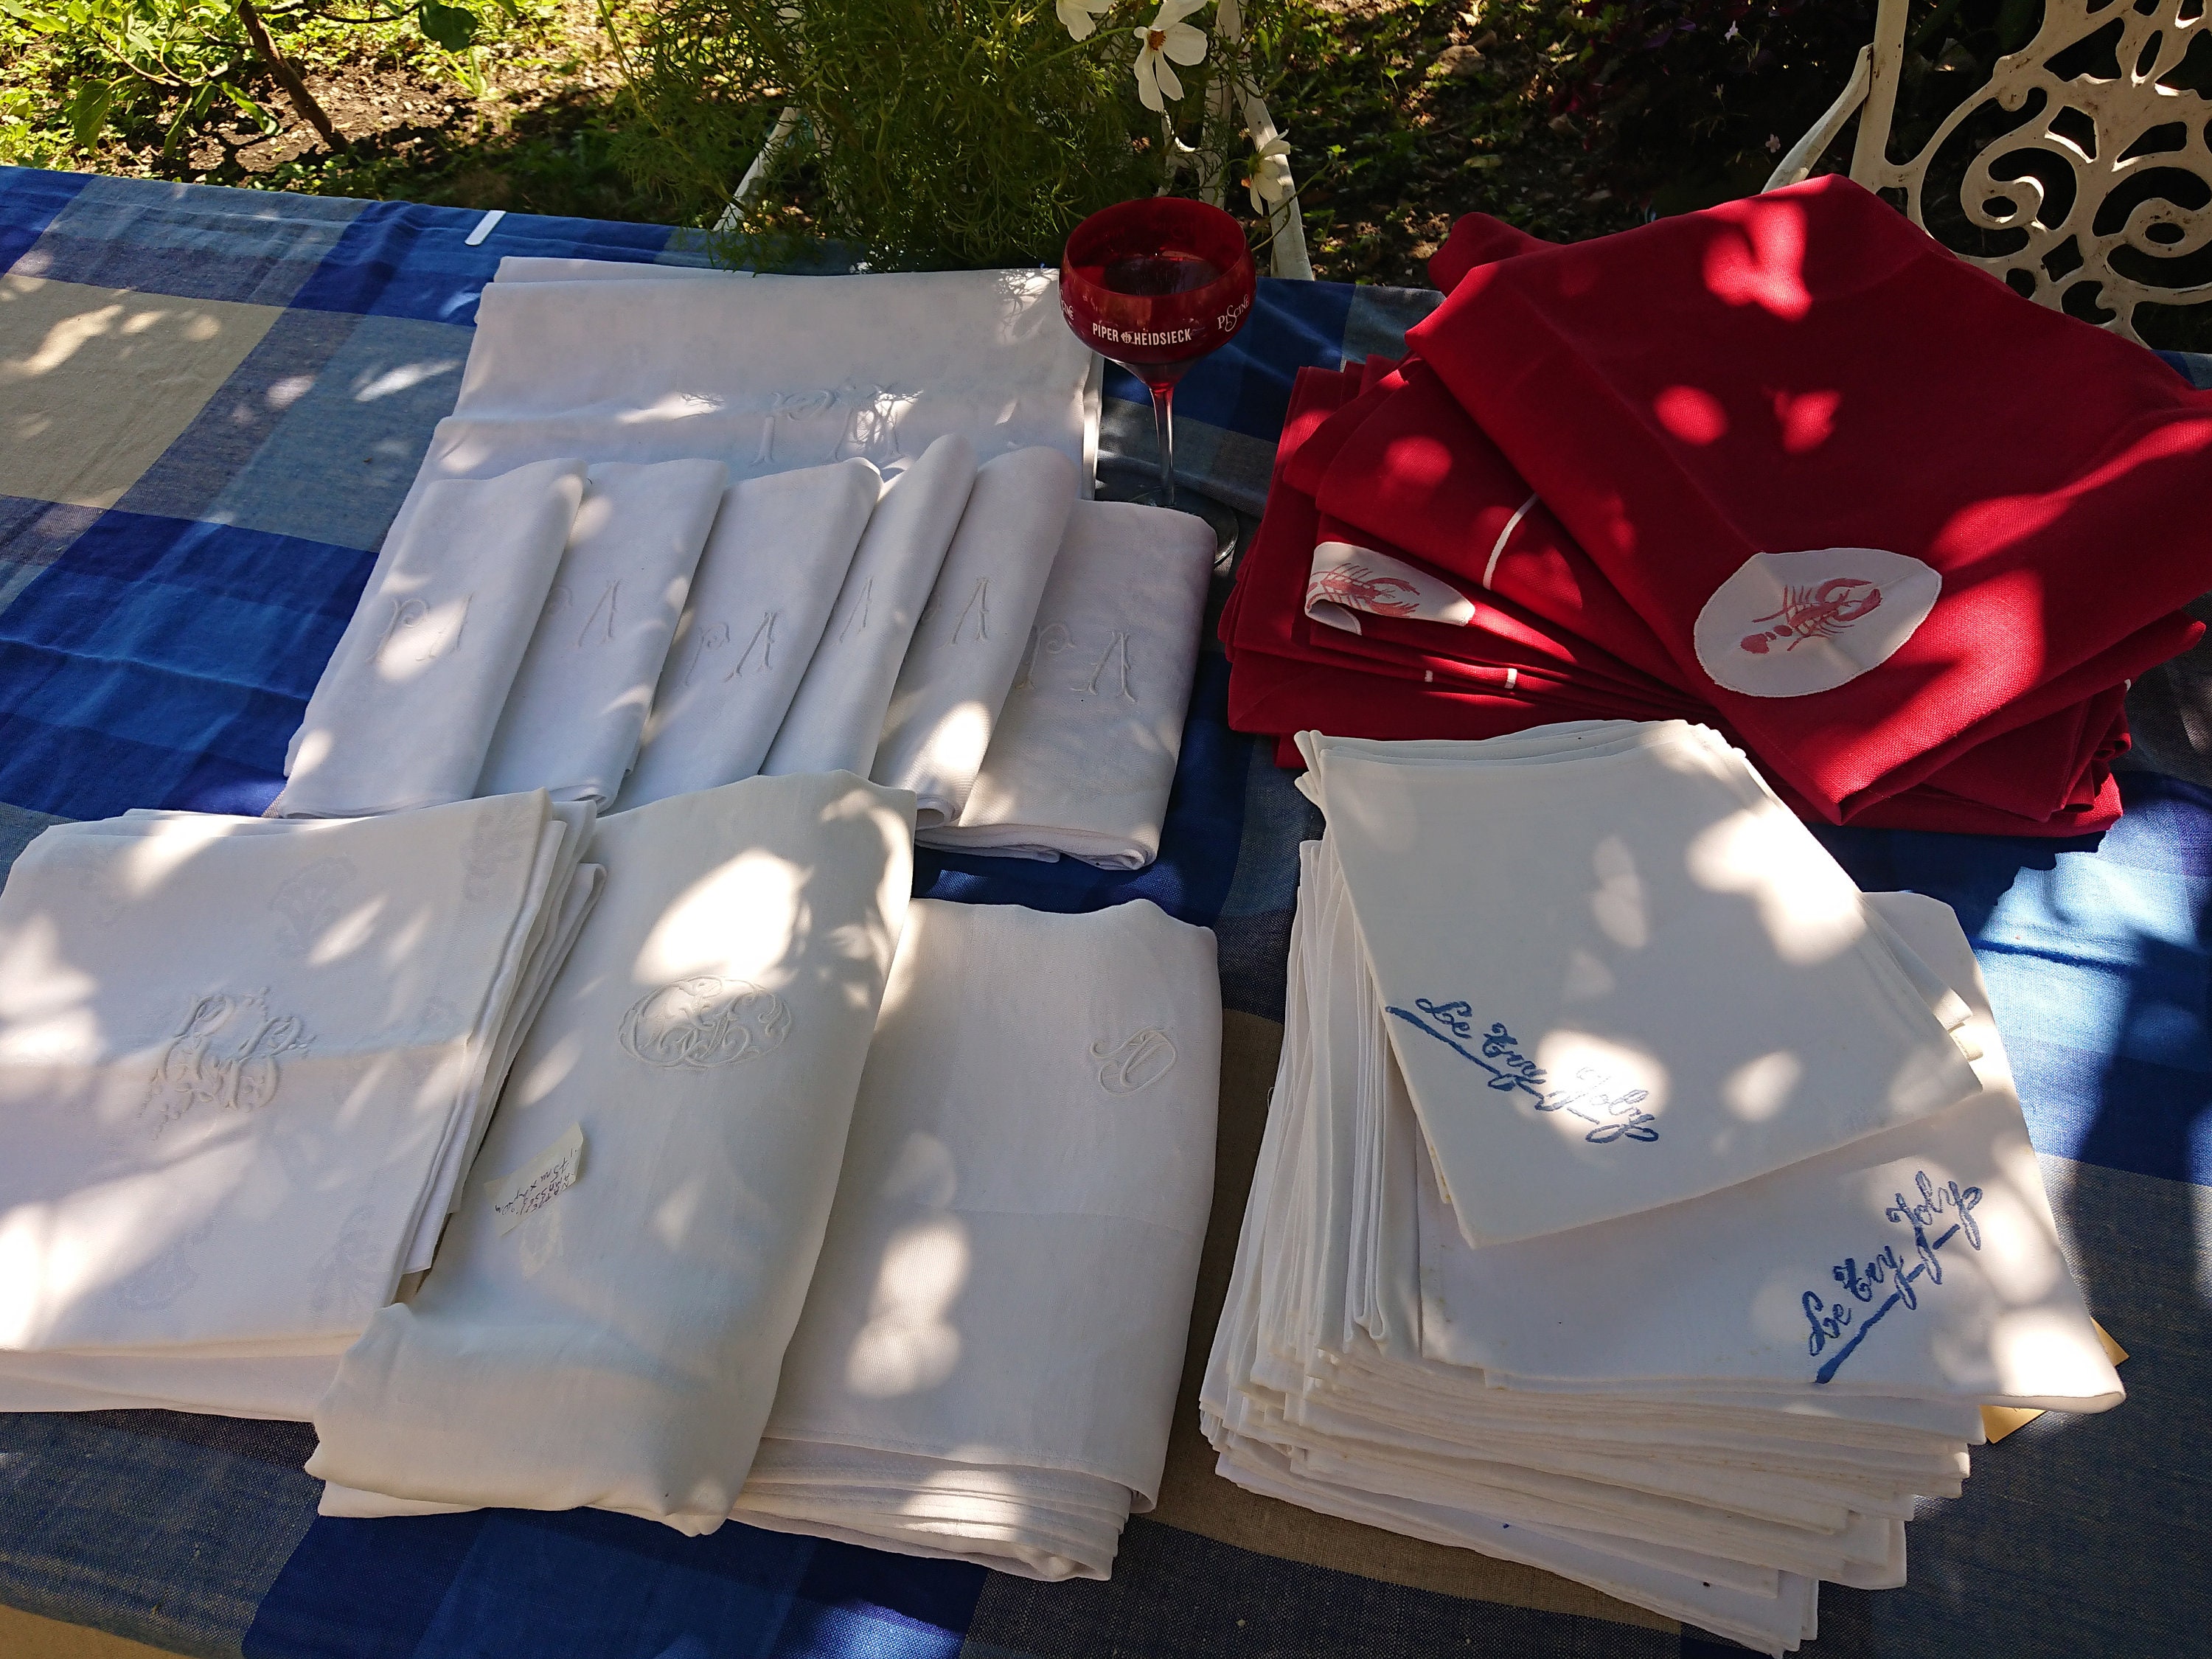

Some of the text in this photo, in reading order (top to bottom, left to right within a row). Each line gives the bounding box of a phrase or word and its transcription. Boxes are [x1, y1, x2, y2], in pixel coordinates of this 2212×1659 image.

[1093, 323, 1192, 345] PIPER HEIDSIECK
[1415, 998, 1472, 1038] Le
[1802, 1290, 1851, 1356] Le
